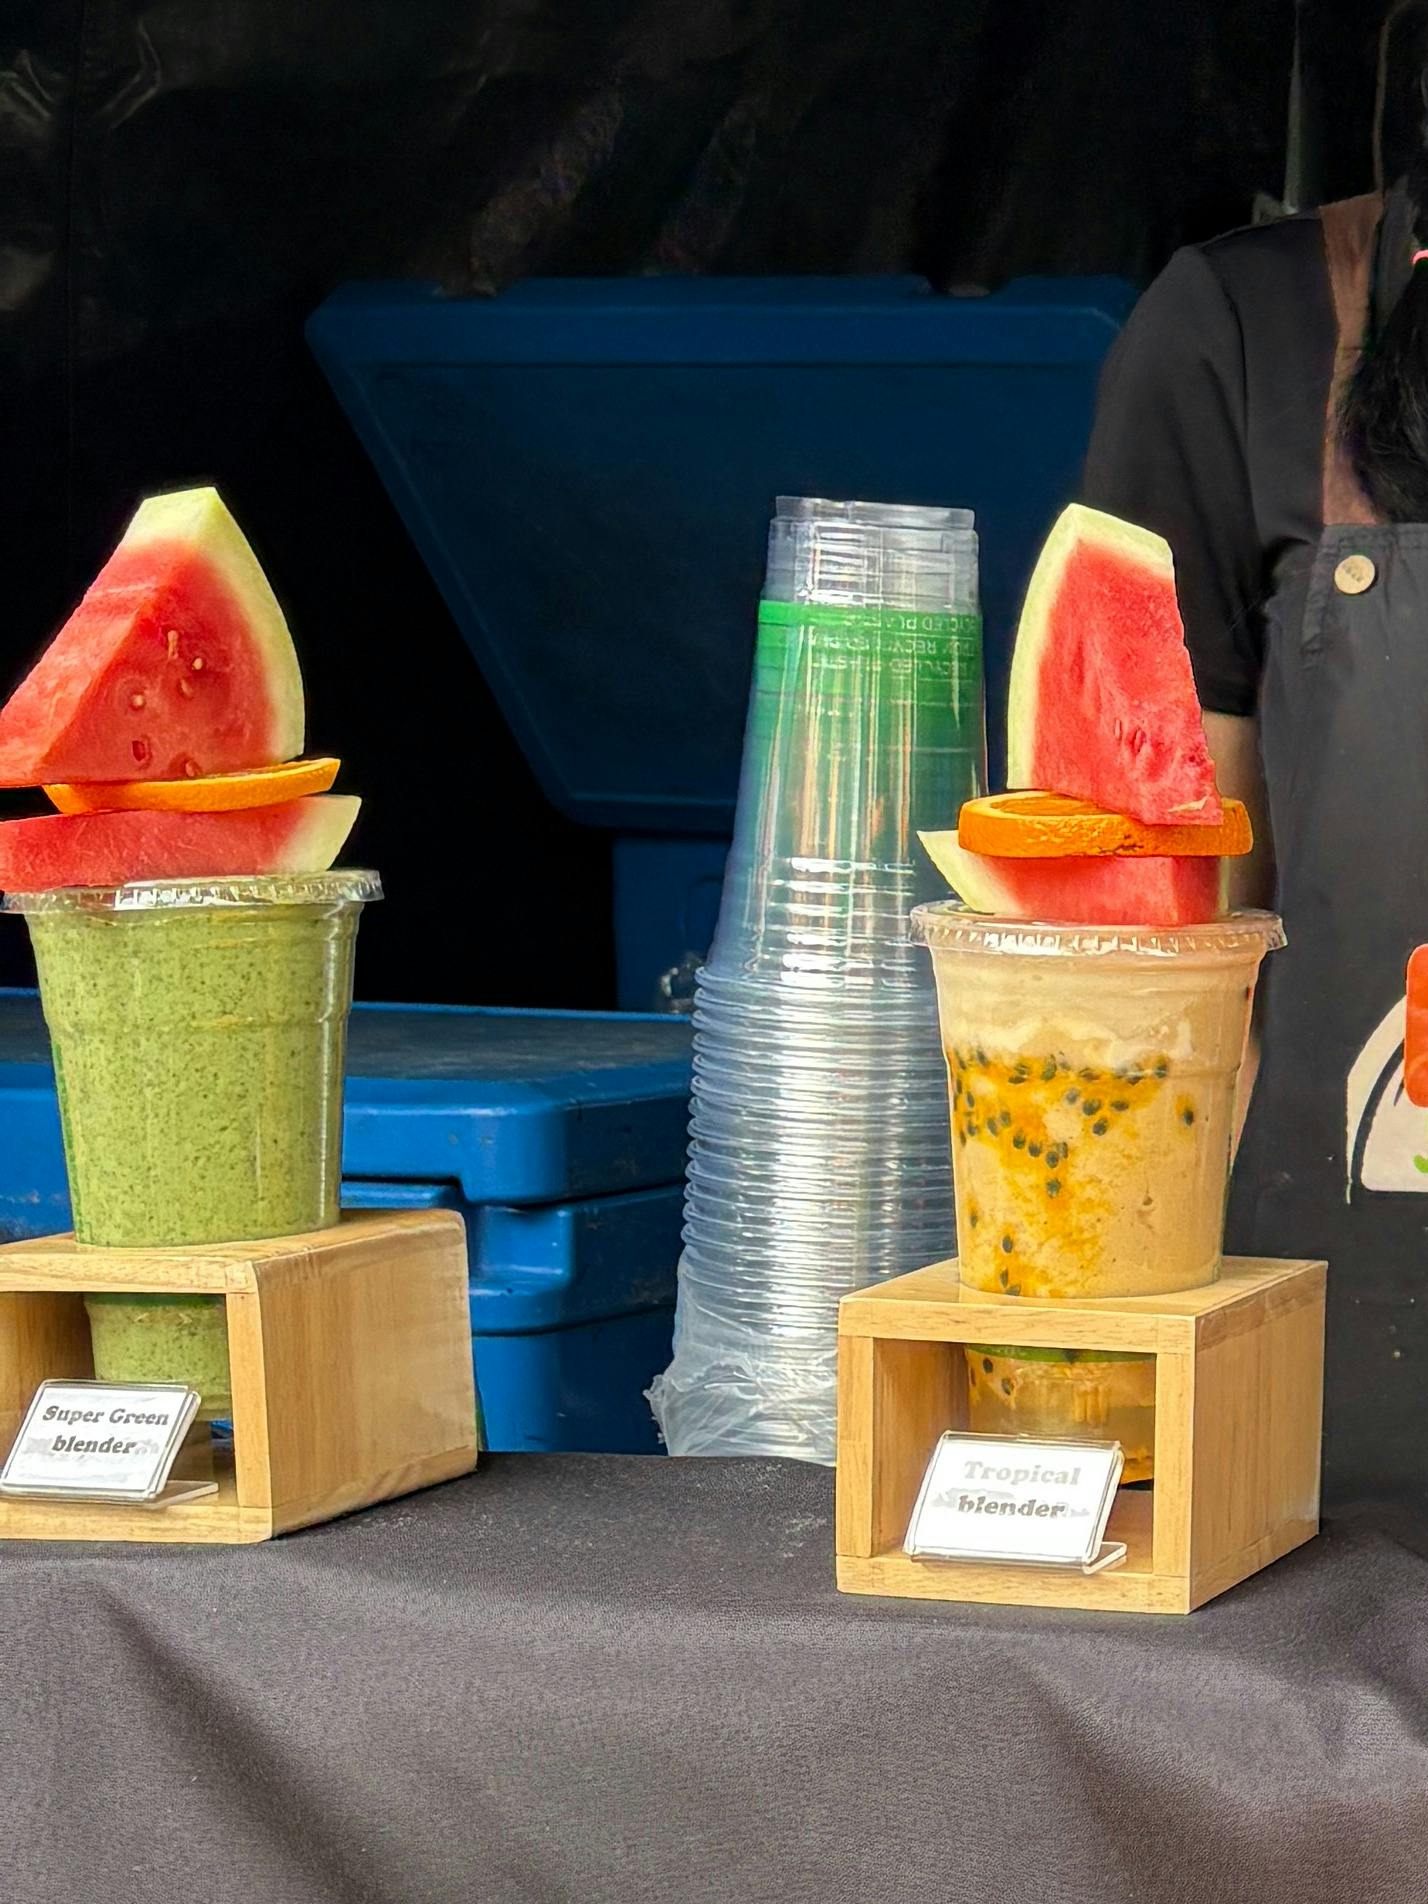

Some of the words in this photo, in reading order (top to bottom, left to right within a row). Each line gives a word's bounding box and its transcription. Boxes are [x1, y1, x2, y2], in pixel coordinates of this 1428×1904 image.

[42, 1404, 105, 1427] Super
[109, 1407, 170, 1427] Green
[51, 1435, 138, 1456] blender
[963, 1460, 1082, 1486] Tropical
[957, 1494, 1067, 1519] blender
